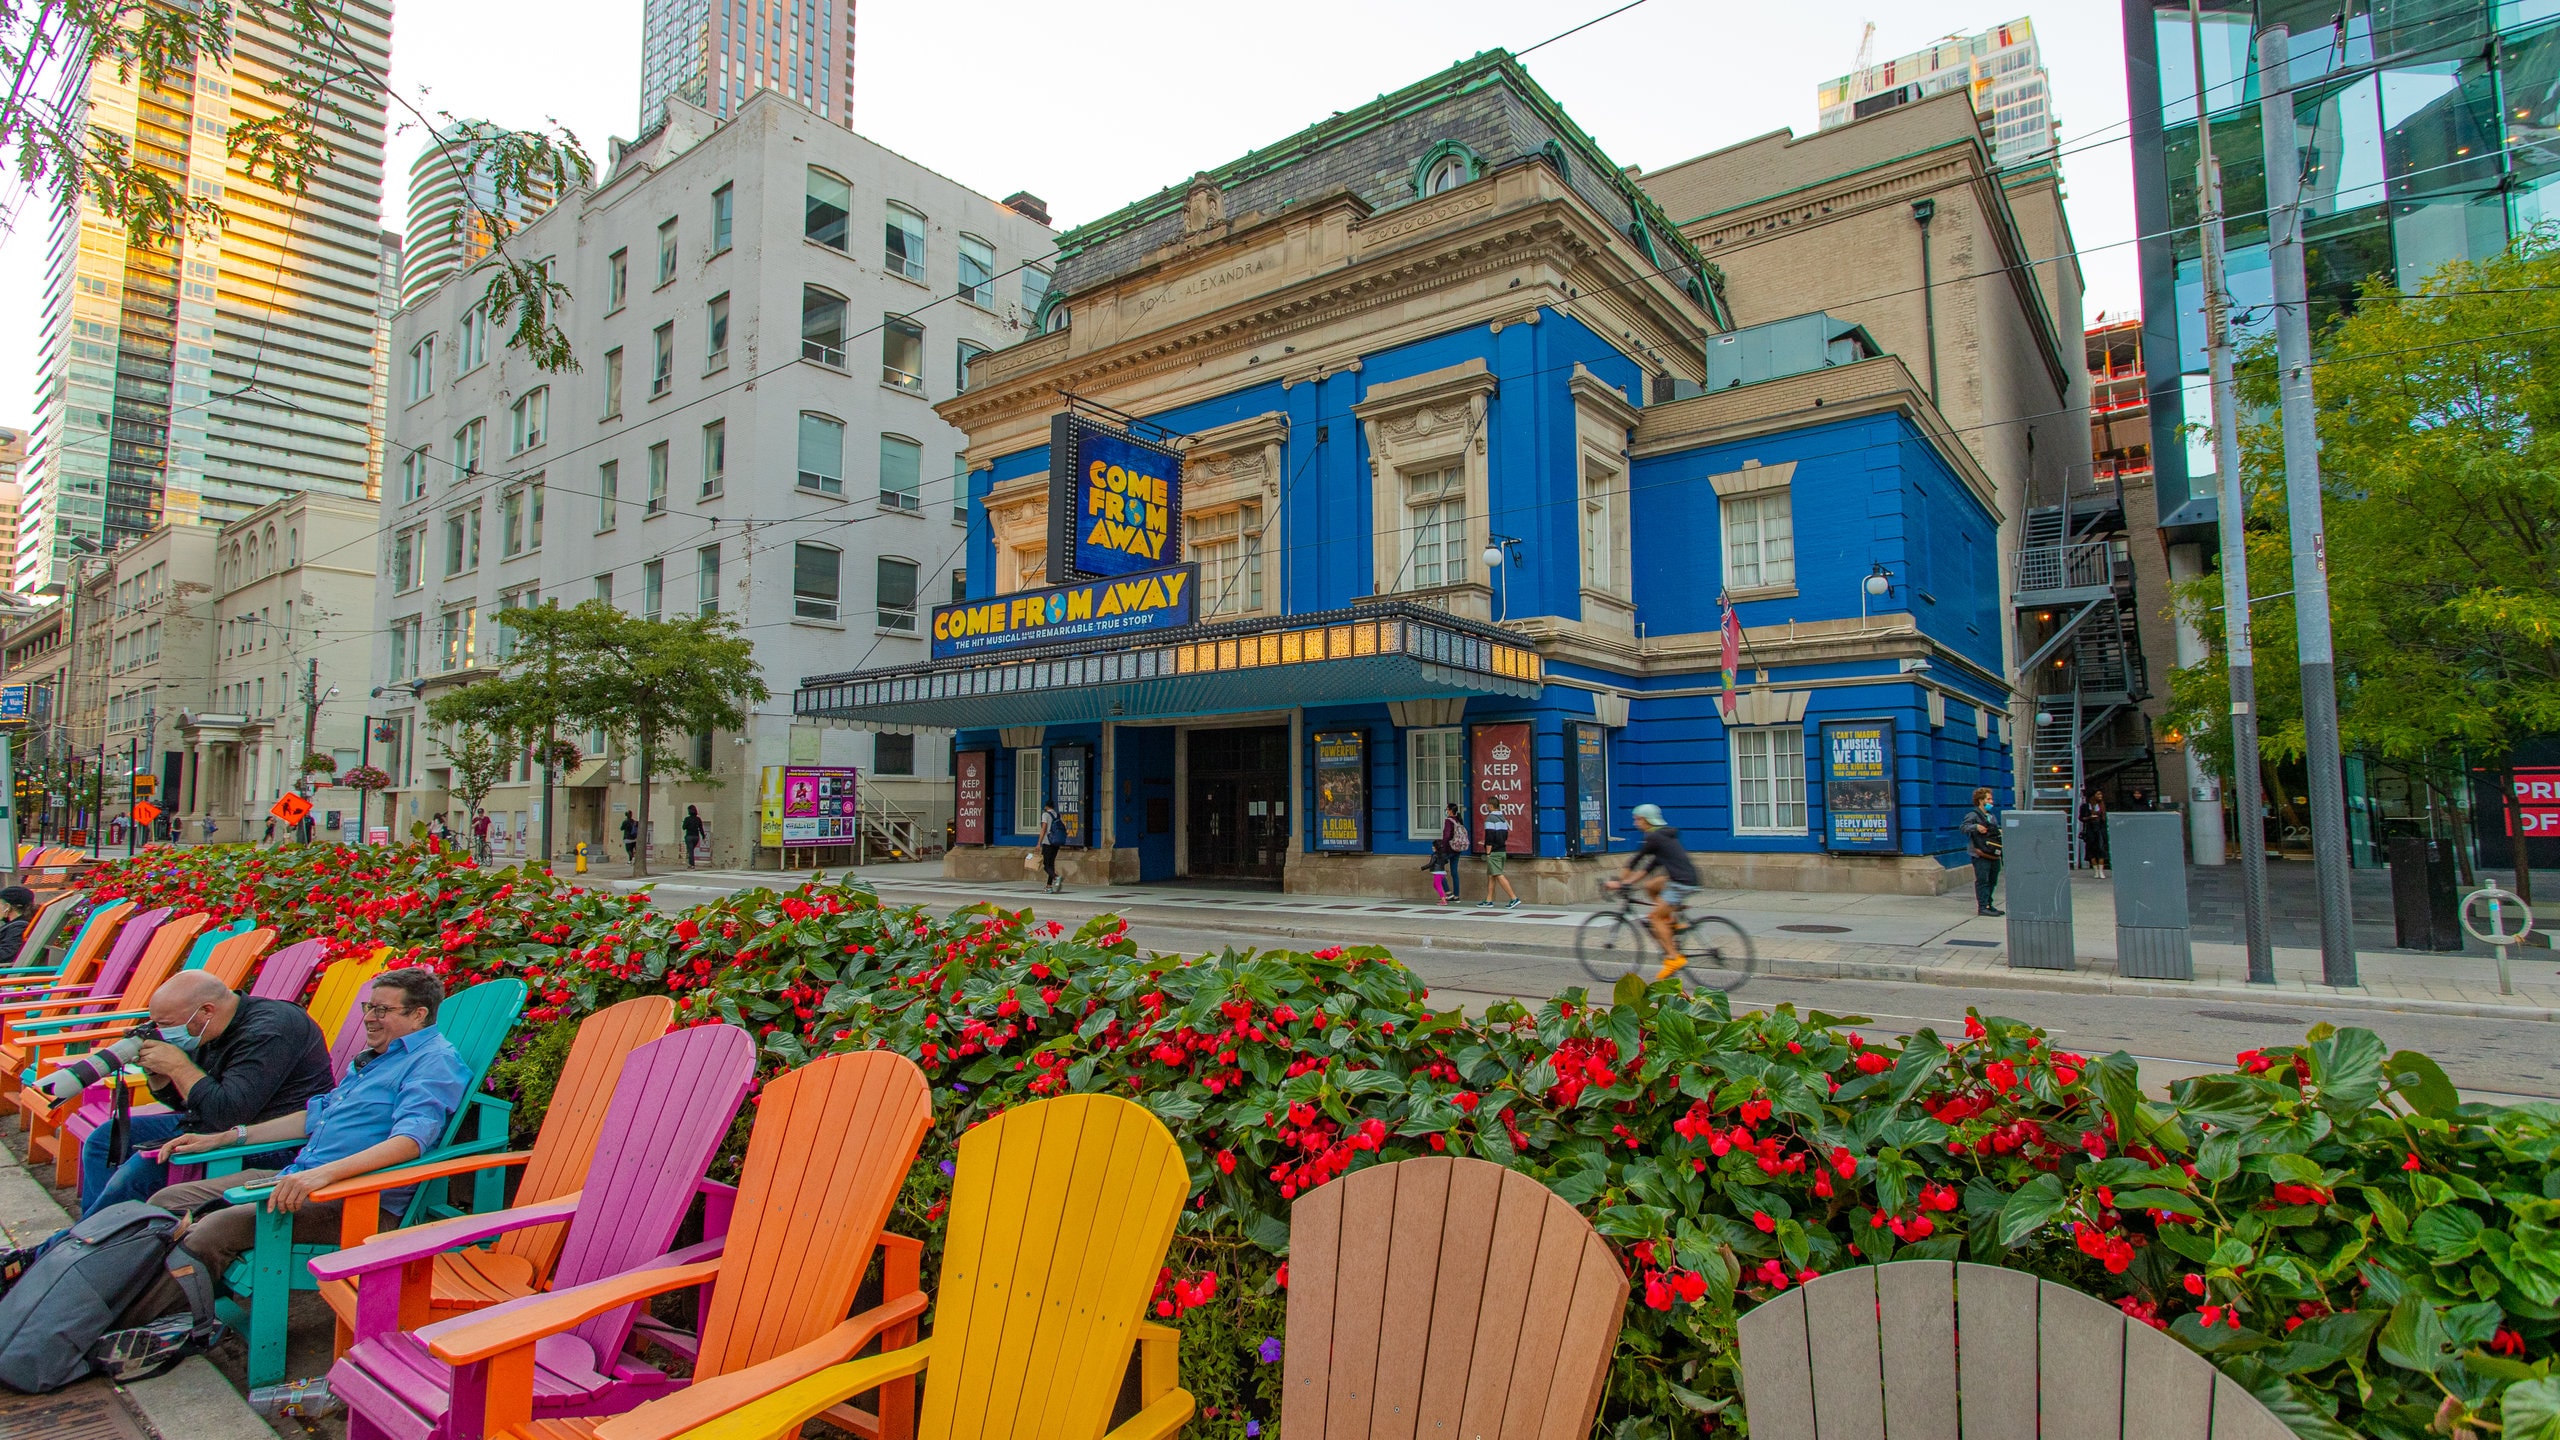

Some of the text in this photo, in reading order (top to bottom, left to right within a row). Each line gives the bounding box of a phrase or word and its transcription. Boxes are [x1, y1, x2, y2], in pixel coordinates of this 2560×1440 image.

[1140, 260, 1264, 313] ROYAL ALEXANDRA
[1089, 460, 1168, 507] COME
[1088, 486, 1168, 535] FROM
[1086, 517, 1167, 560] AWAY
[934, 572, 1188, 640] COME FROM AWAY
[1036, 613, 1155, 639] REMARKABLE TRUE STORY
[955, 633, 1021, 650] THE HIT MUSICAL
[1854, 730, 1881, 739] IMAGINE
[1832, 738, 1882, 750] A MUSICAL
[1320, 745, 1359, 757] POWERFUL
[1832, 750, 1882, 763] WE NEED
[1058, 766, 1080, 781] COME
[1484, 764, 1519, 776] KEEP
[962, 779, 980, 788] KEEP
[1057, 781, 1079, 796] FROM
[1481, 779, 1522, 791] CALM
[960, 790, 982, 799] CALM
[959, 807, 982, 817] CARRY
[1058, 802, 1079, 813] WE ALL
[1479, 803, 1525, 815] CRRY
[965, 819, 976, 828] ON
[1322, 817, 1357, 830] A GLOBAL
[1835, 819, 1888, 828] DEEPLY MOVED
[1322, 830, 1358, 839] PHENOMENON
[2284, 825, 2311, 841] 22
